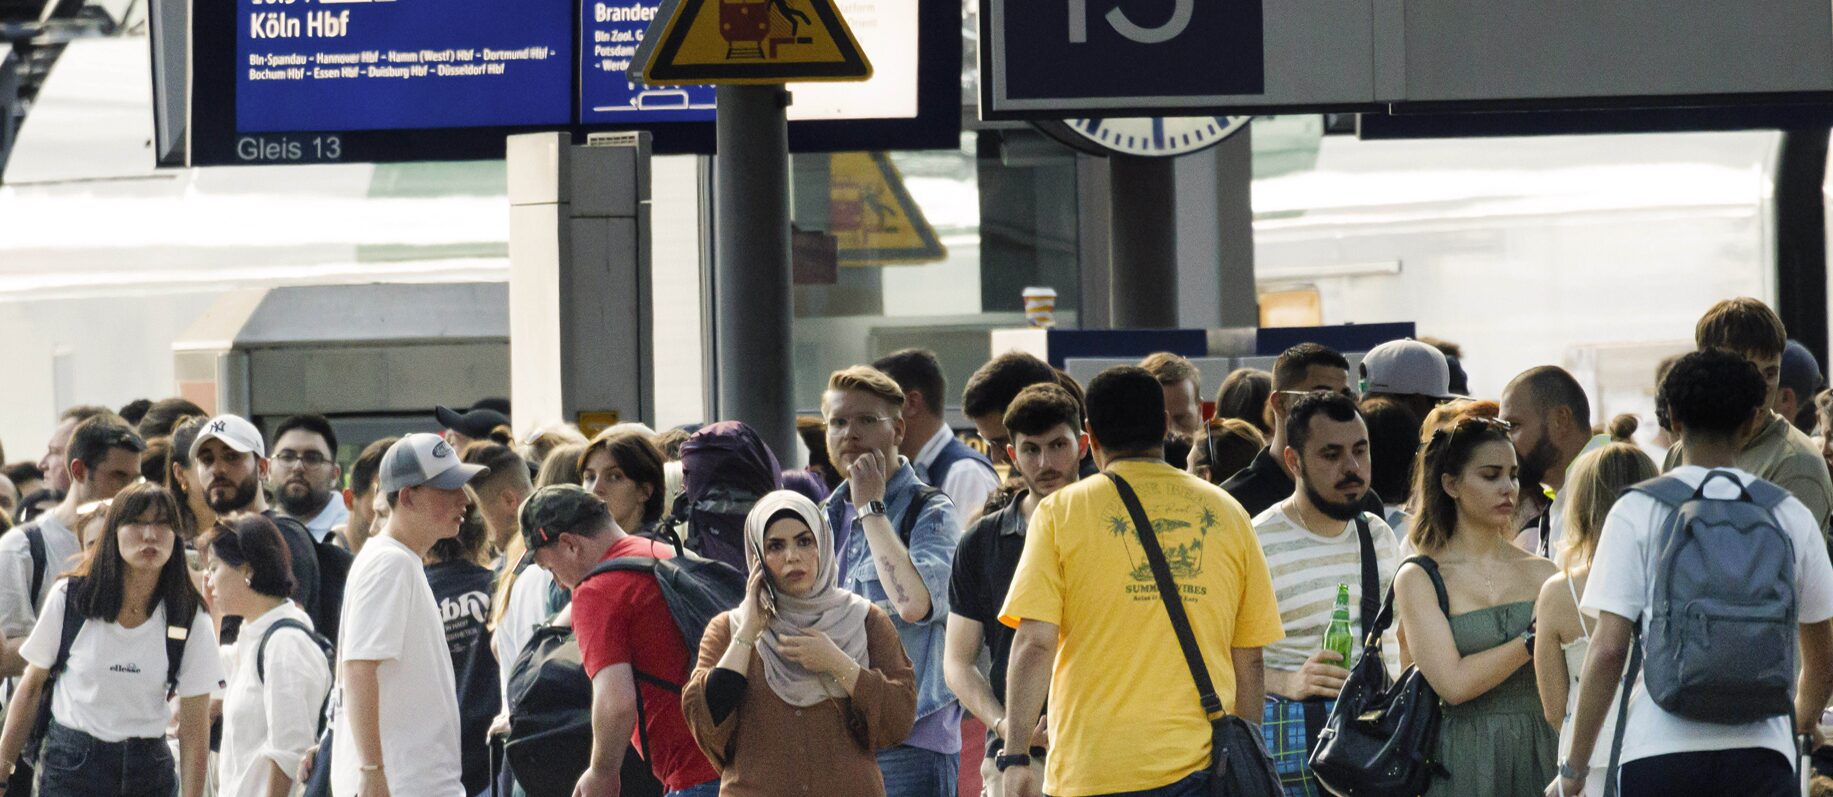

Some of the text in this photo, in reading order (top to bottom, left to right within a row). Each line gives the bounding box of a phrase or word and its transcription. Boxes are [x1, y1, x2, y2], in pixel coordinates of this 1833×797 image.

[595, 2, 660, 22] Branden
[250, 10, 350, 38] Köln Hbf
[316, 52, 359, 64] Hannover
[361, 51, 379, 62] Hbf
[388, 51, 418, 63] Hamm
[419, 49, 455, 63] (Westf)
[456, 49, 474, 61] Hbf
[483, 48, 529, 60] Dortmund
[529, 46, 549, 59] Hbf
[250, 68, 286, 80] Bochum
[287, 68, 305, 79] Hbf
[314, 67, 340, 79] Essen
[341, 67, 359, 78] Hbf
[368, 65, 409, 79] Duisburg
[410, 65, 428, 77] Hbf
[437, 63, 487, 77] Düsseldorf
[488, 63, 505, 75] Hbf
[237, 136, 341, 159] Gleis 13
[1125, 584, 1160, 593] SUMM
